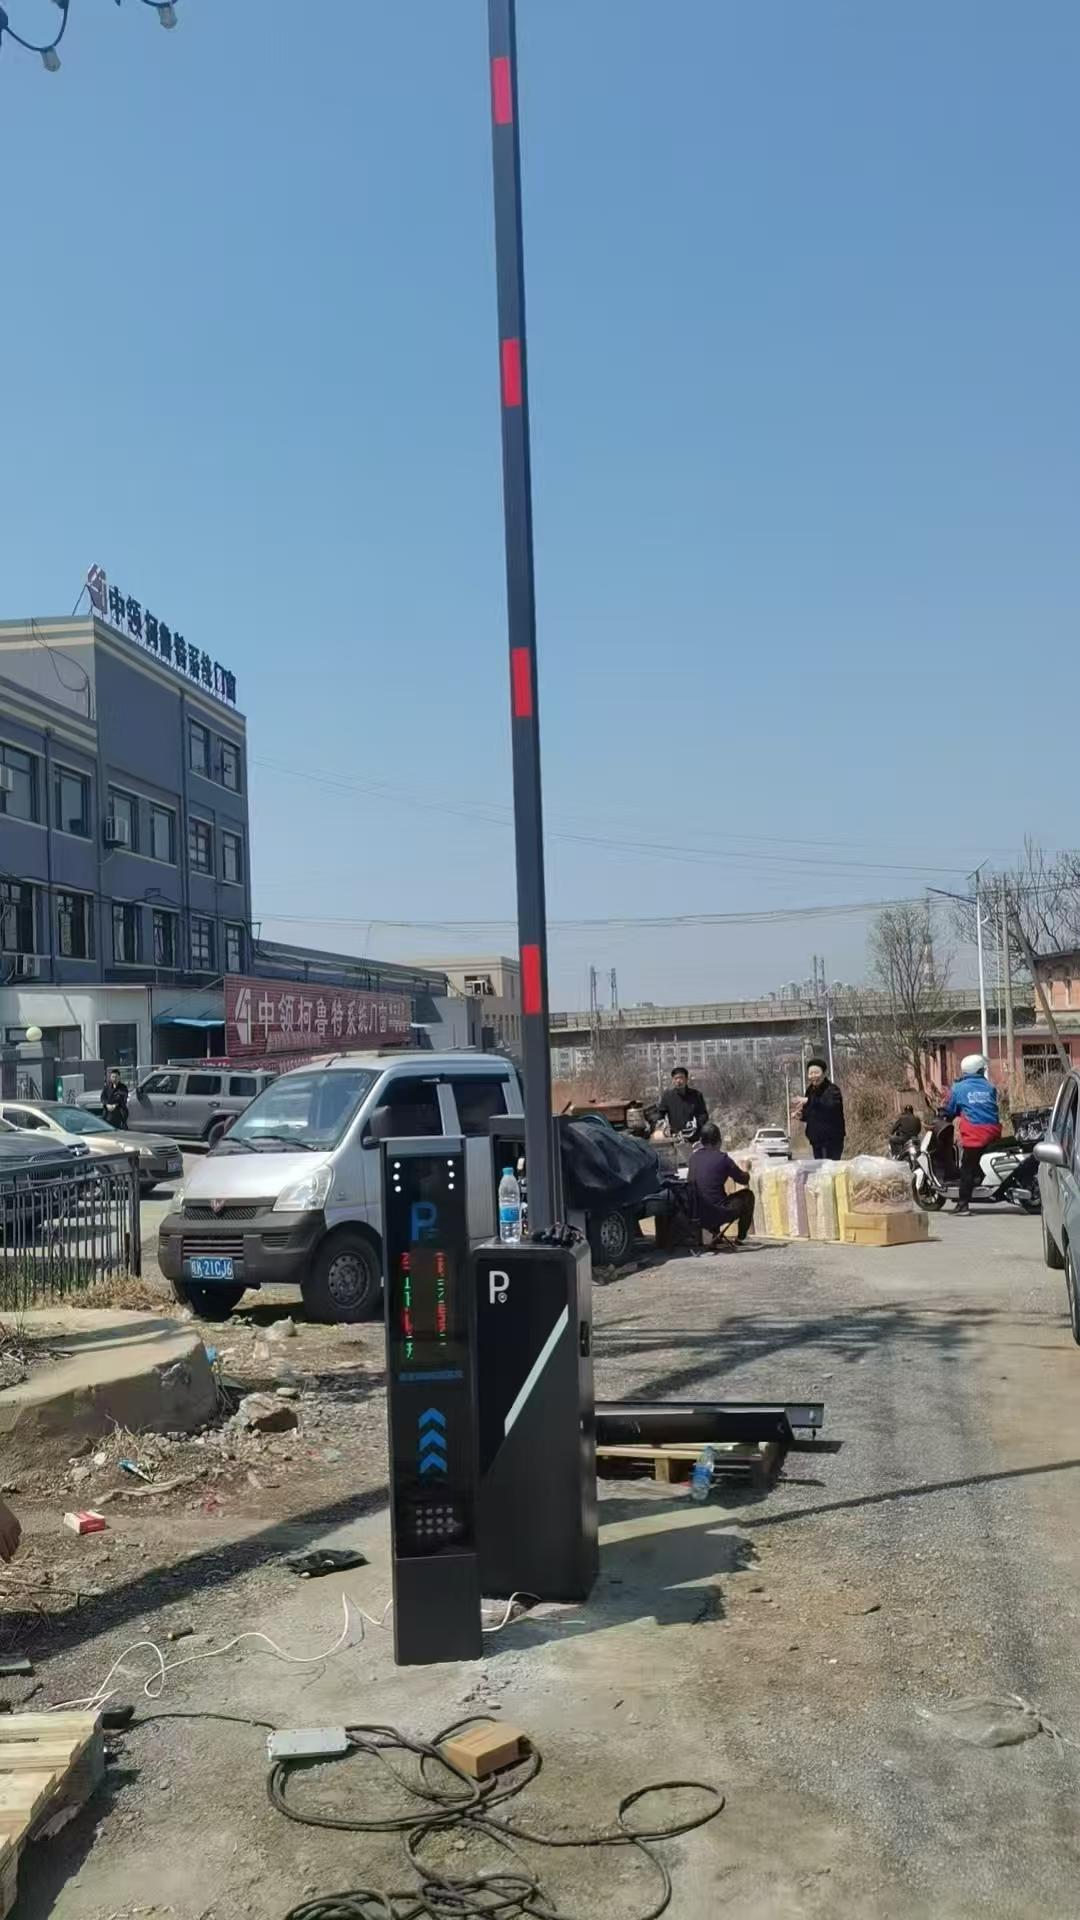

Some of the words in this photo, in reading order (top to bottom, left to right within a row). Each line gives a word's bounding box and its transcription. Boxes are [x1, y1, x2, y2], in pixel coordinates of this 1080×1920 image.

[258, 991, 388, 1039] 中领柯鲁特系统门窗
[488, 1270, 510, 1304] P
